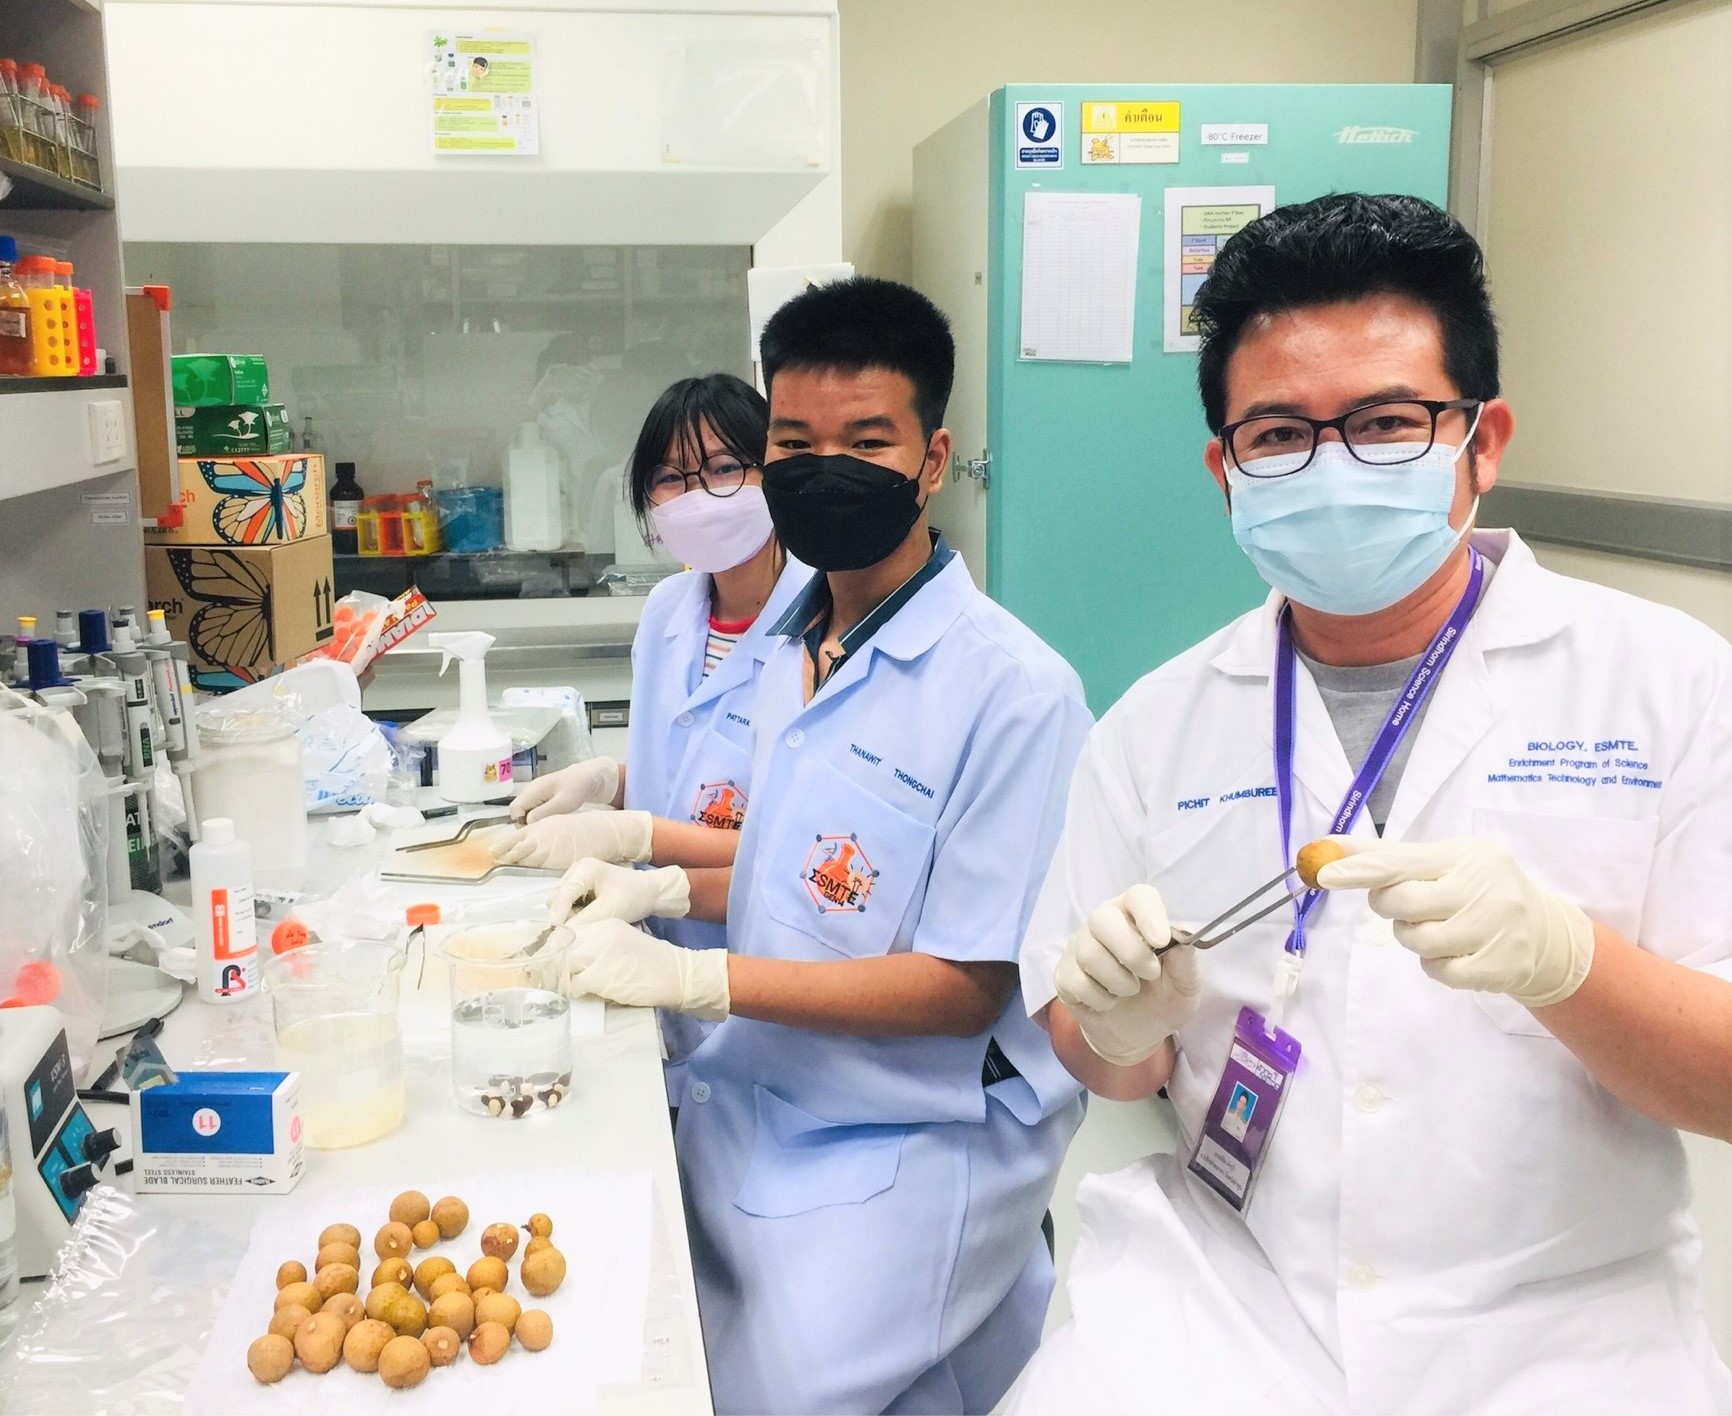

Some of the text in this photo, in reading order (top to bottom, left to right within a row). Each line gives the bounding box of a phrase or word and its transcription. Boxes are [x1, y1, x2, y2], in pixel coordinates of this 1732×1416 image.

[1230, 132, 1262, 141] Freezer
[1391, 626, 1457, 727] Sirindhorn Science Home
[142, 738, 151, 760] RNA
[850, 743, 935, 799] THANAWIT THONGCHAI
[1509, 758, 1649, 771] Enrichment Program of Science
[1487, 774, 1542, 783] Mathematics
[1547, 774, 1597, 787] Technology
[1601, 775, 1617, 784] and
[1177, 797, 1210, 811] PICHIT
[1334, 789, 1362, 833] Sirindhorn
[198, 1115, 217, 1130] 11
[144, 1176, 168, 1185] BLADE
[171, 1176, 208, 1186] SURGICAL
[210, 1176, 243, 1186] FEATHER
